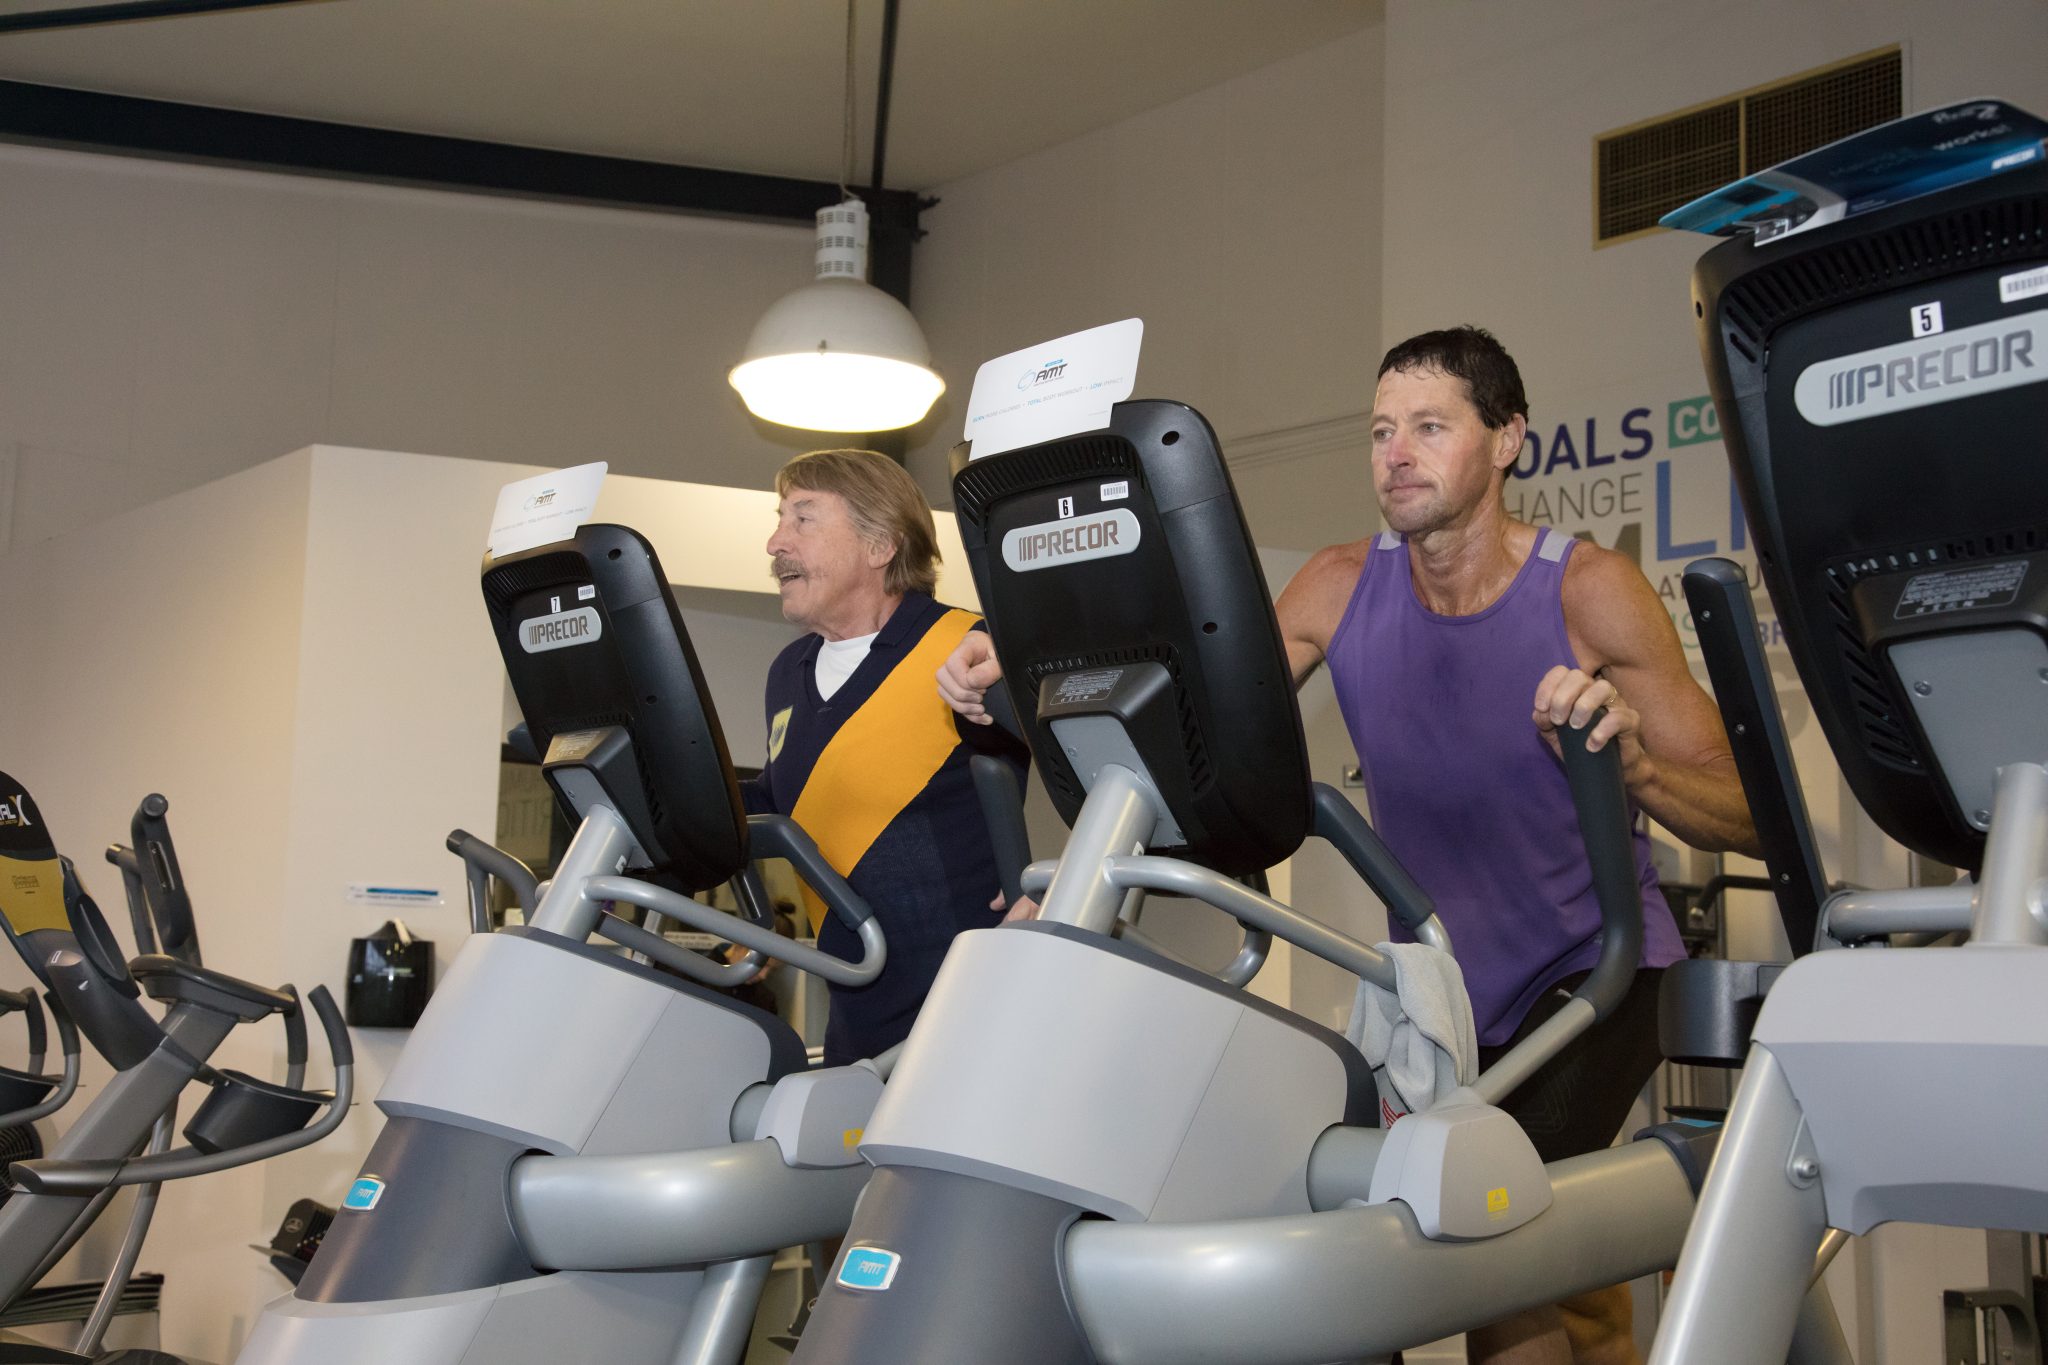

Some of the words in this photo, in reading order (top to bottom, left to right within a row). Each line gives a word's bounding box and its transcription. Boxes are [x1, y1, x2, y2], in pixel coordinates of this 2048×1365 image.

[1919, 307, 1932, 333] 5
[1034, 363, 1068, 383] AMT
[1856, 329, 2035, 406] PRECOR
[1062, 499, 1070, 516] 6
[1032, 519, 1120, 561] PRECOR
[553, 598, 559, 612] 7
[536, 615, 590, 645] PRECOR
